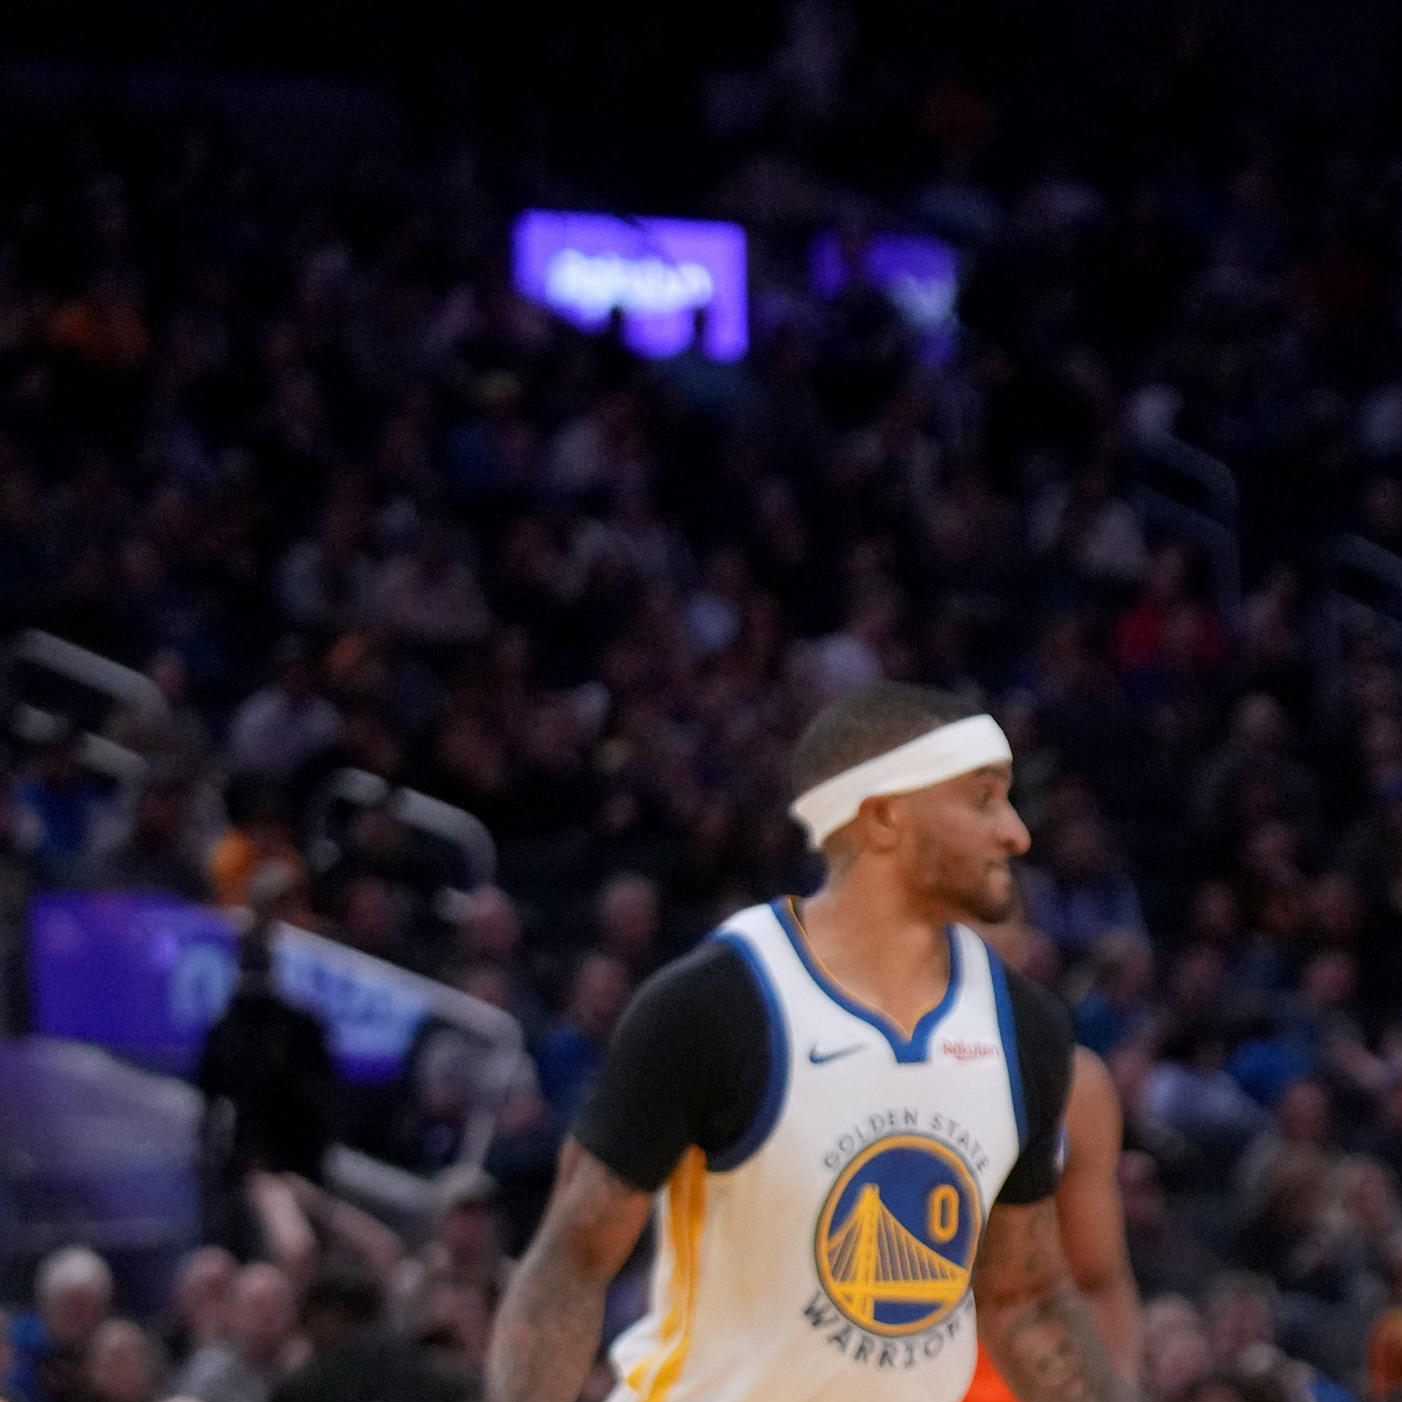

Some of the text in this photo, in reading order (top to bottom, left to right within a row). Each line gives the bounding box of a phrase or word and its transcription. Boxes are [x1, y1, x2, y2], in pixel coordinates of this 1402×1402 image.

[823, 1108, 990, 1175] GOLDEN STATE
[929, 1183, 960, 1243] 0
